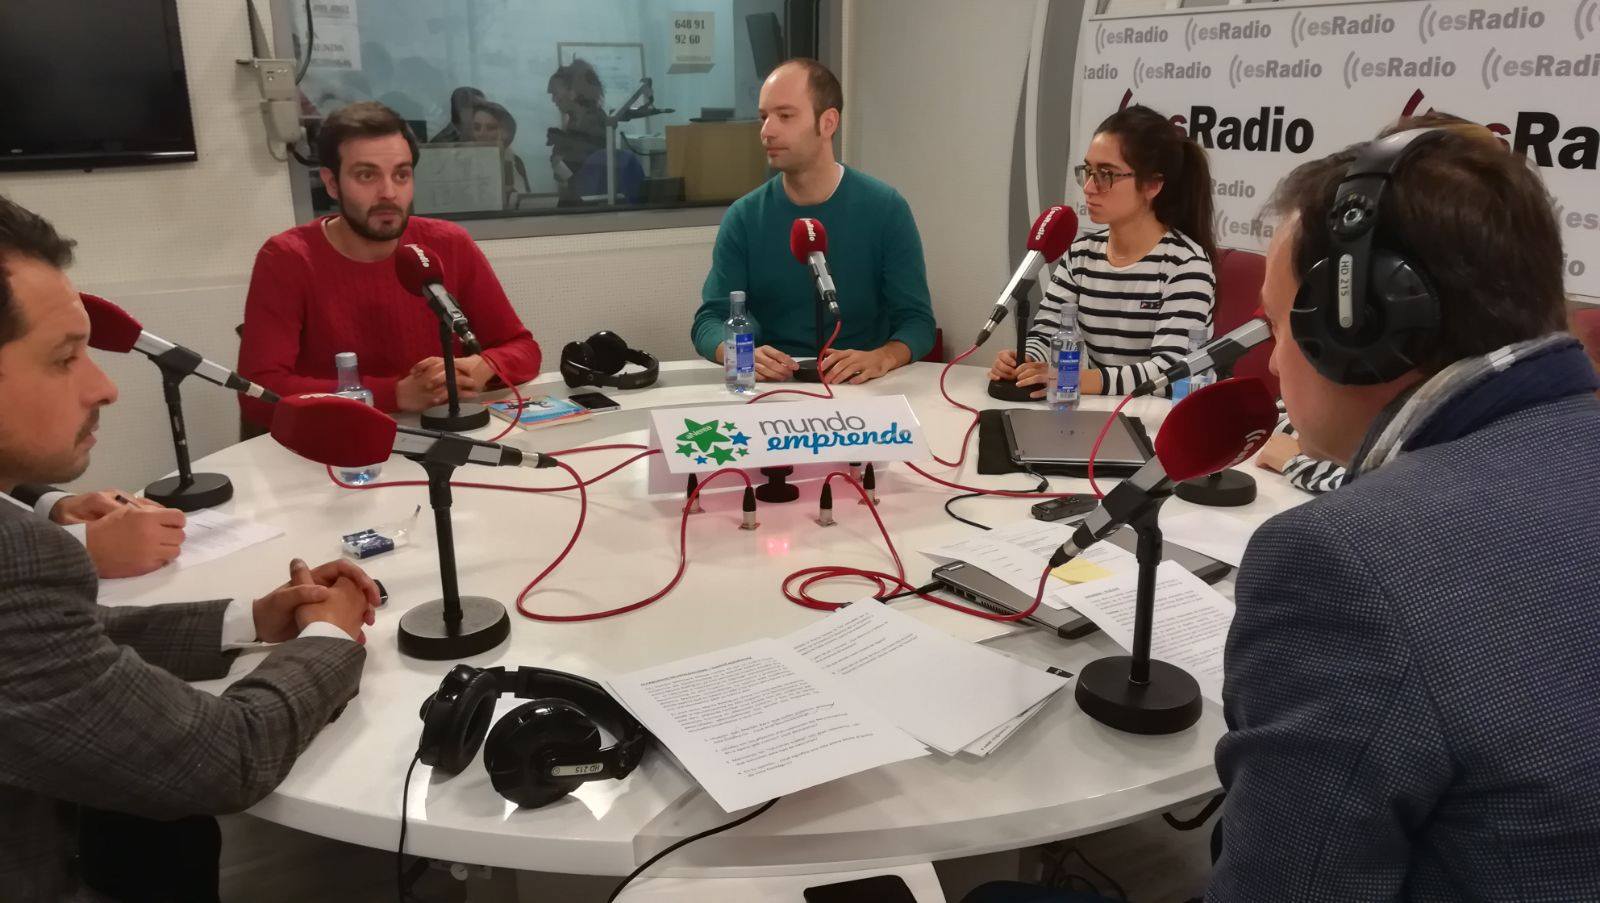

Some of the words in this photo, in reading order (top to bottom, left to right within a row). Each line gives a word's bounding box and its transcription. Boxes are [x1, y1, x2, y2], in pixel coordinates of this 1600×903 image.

[1307, 13, 1395, 37] esRadio
[1438, 6, 1546, 32] esRadio
[1106, 26, 1168, 44] esRadio
[1198, 20, 1271, 42] esRadio
[1145, 62, 1212, 79] esRadio
[1244, 59, 1322, 78] esRadio
[1361, 56, 1456, 78] esRadio
[758, 411, 866, 436] mundo
[766, 422, 914, 454] emprende
